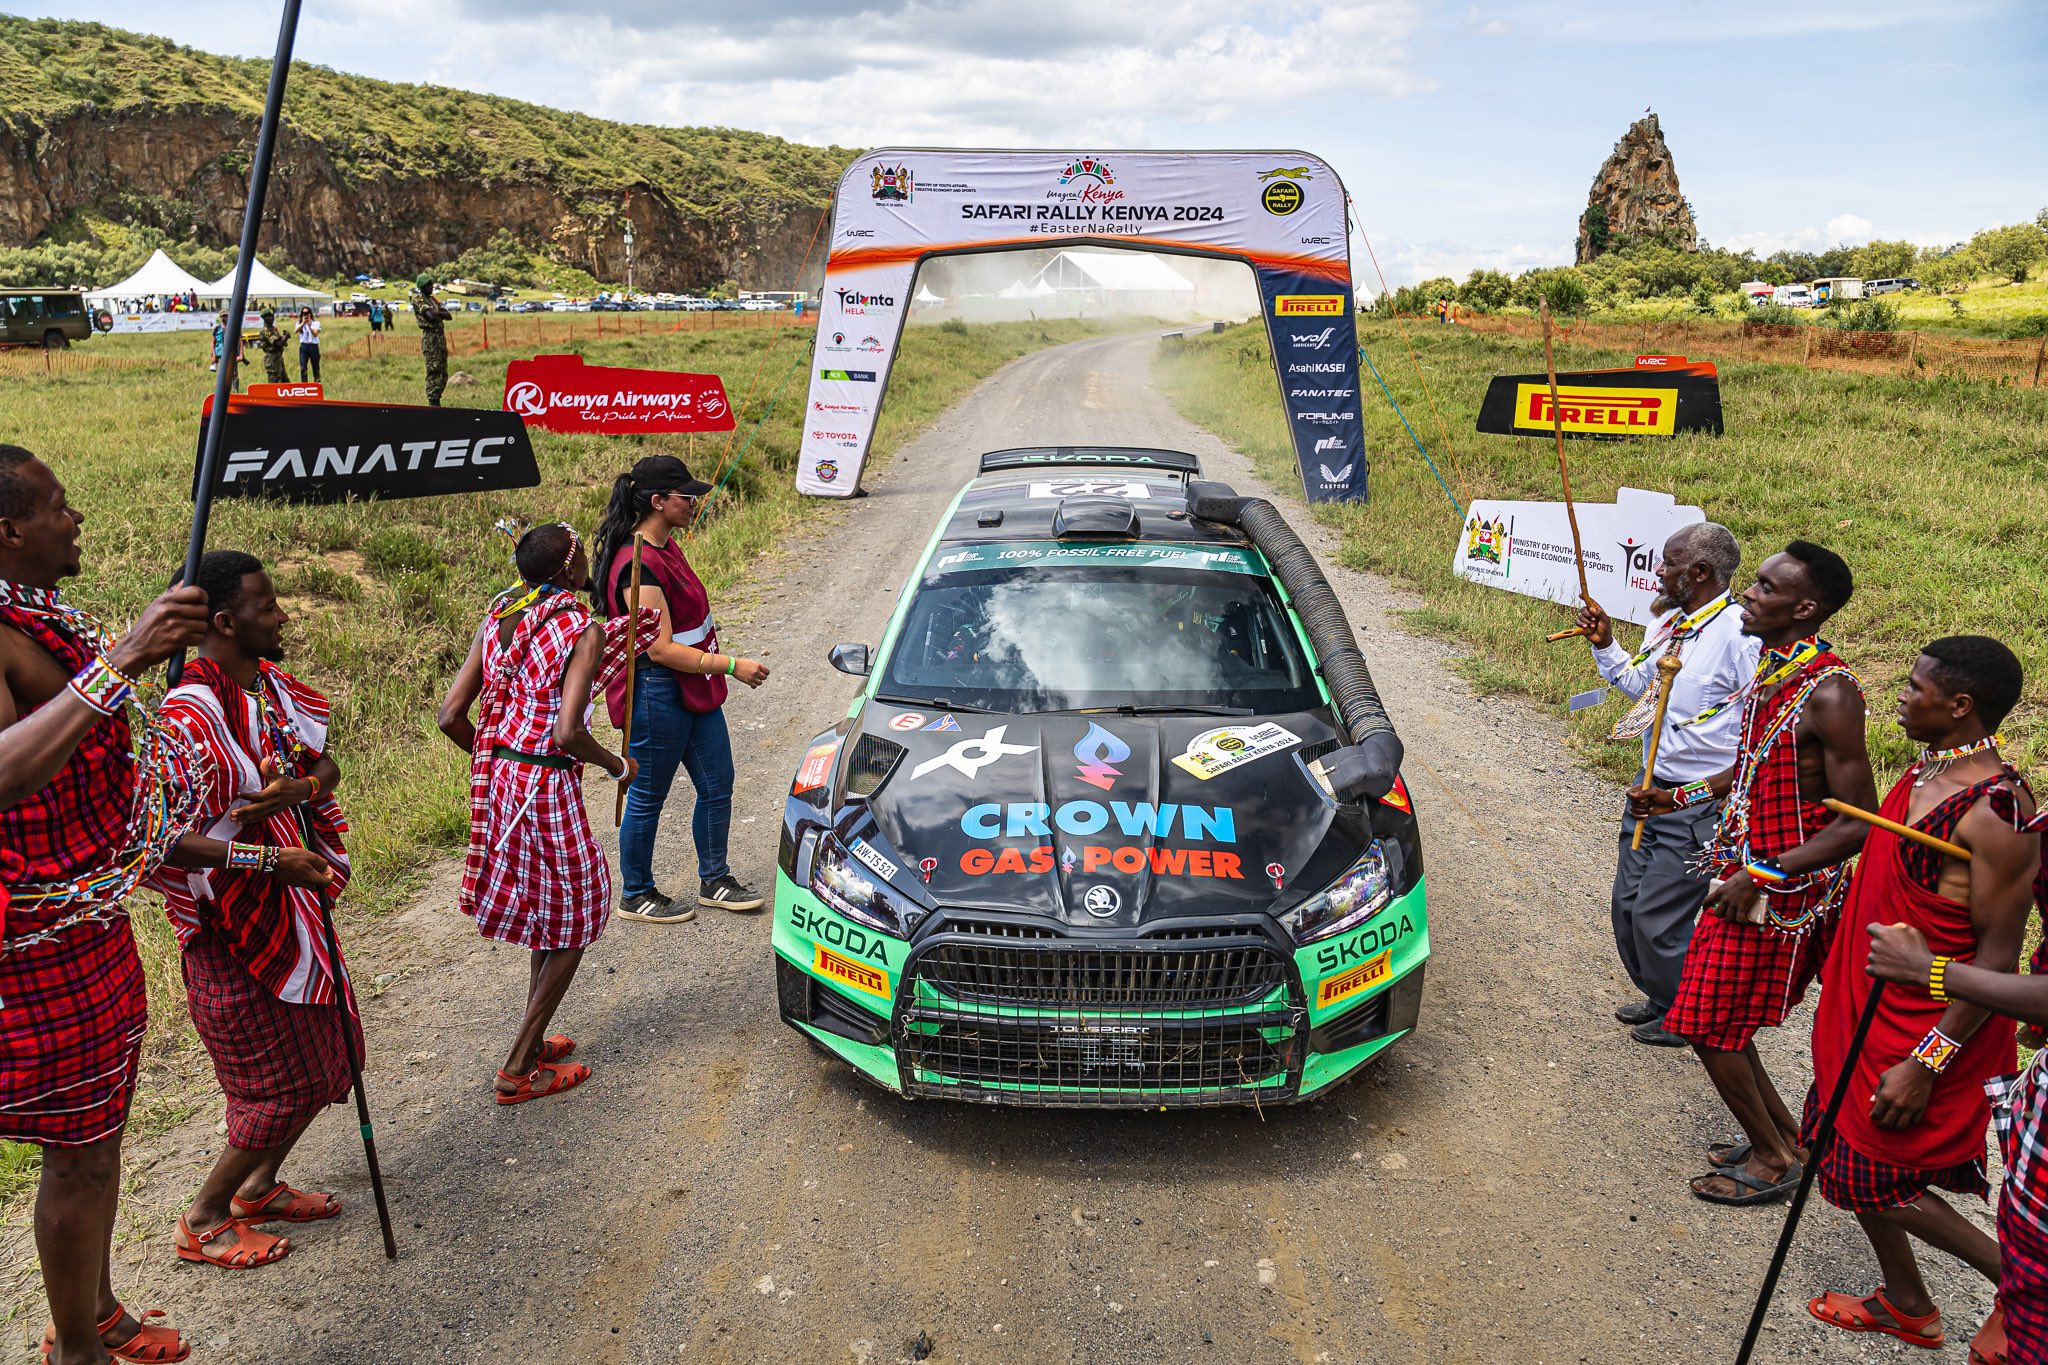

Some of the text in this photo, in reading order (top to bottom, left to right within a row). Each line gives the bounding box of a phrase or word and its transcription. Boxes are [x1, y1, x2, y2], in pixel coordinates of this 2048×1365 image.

[1082, 183, 1125, 205] Kenya
[962, 204, 1225, 221] SAFARI RALLY KENYA 2024
[846, 229, 875, 238] WRC
[1029, 222, 1143, 236] #EasterNaRally
[1301, 237, 1330, 245] WRC
[845, 307, 865, 315] HELA
[1282, 299, 1338, 312] PIRELLI
[1288, 363, 1346, 373] AsahiKASEI
[277, 386, 319, 397] WRC
[549, 391, 691, 409] Kenya Airways
[580, 410, 692, 423] The Pride of Africa
[1529, 393, 1662, 426] PIRELLI
[825, 432, 857, 440] TOYOTA
[997, 549, 1042, 559] 100%
[1046, 548, 1145, 557] FOSSIL-FREE
[1149, 549, 1189, 559] FUEL
[1512, 538, 1540, 549] MINISTRY
[1551, 545, 1573, 554] YOUTH
[1574, 549, 1601, 561] FAIRS,
[1512, 547, 1614, 572] CREATIVE ECONOMY AD SPORTS
[1631, 576, 1659, 592] HELA
[895, 715, 920, 728] E
[1206, 761, 1234, 774] SAFARI
[1232, 752, 1254, 764] RALLY
[1254, 744, 1276, 755] KENYA
[1275, 737, 1294, 747] 2024
[961, 801, 1236, 843] CROWN
[855, 844, 896, 878] AW-TS 521
[960, 846, 1245, 880] GAS POWER
[820, 950, 883, 991] PIRELLI
[1324, 955, 1385, 1000] PIRELLI
